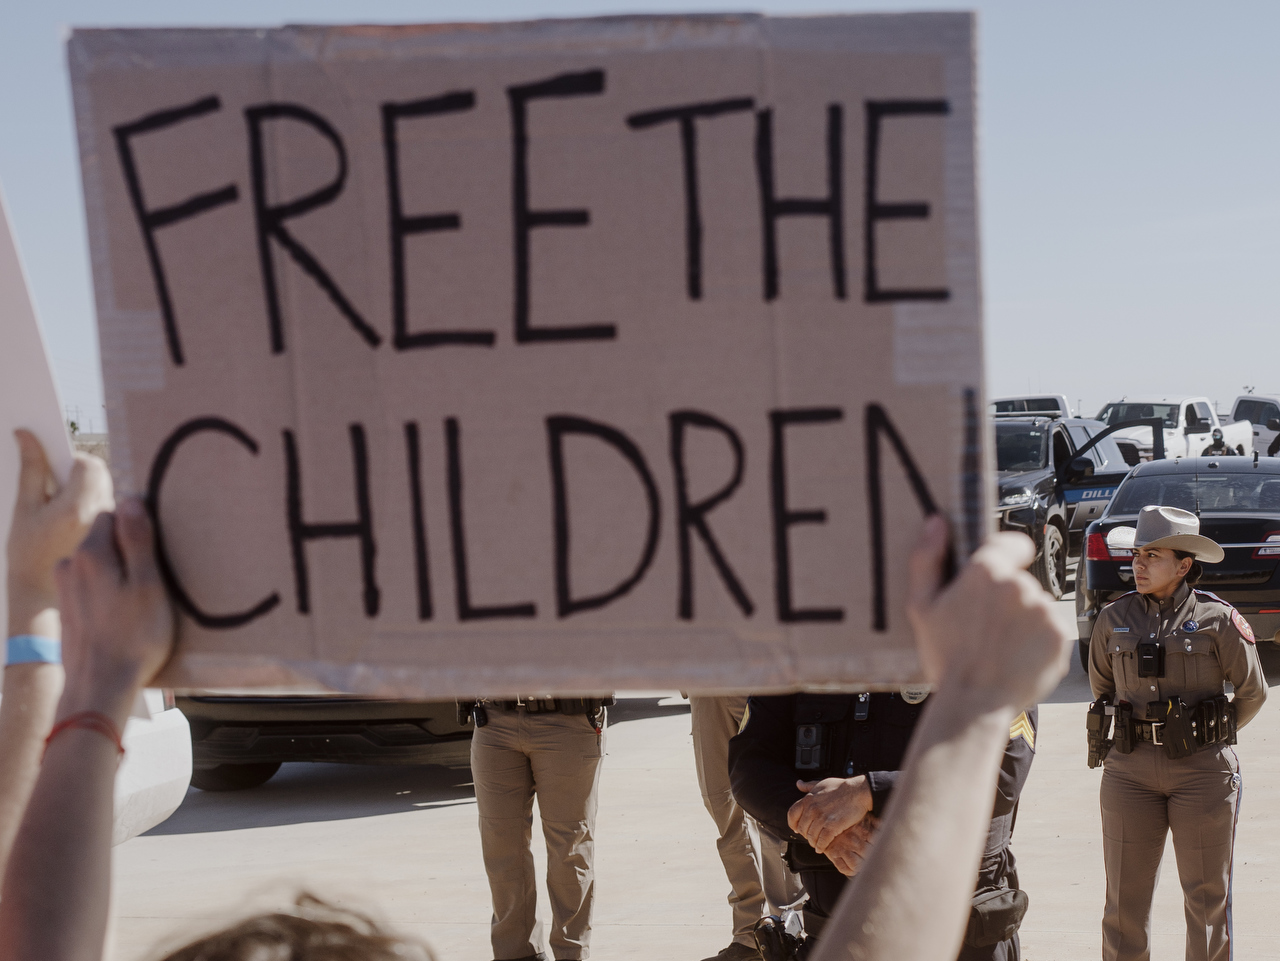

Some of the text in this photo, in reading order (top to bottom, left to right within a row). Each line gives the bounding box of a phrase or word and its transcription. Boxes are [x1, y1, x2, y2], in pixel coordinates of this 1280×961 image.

[113, 69, 950, 366] FREE THE
[146, 388, 975, 632] CHILDREN
